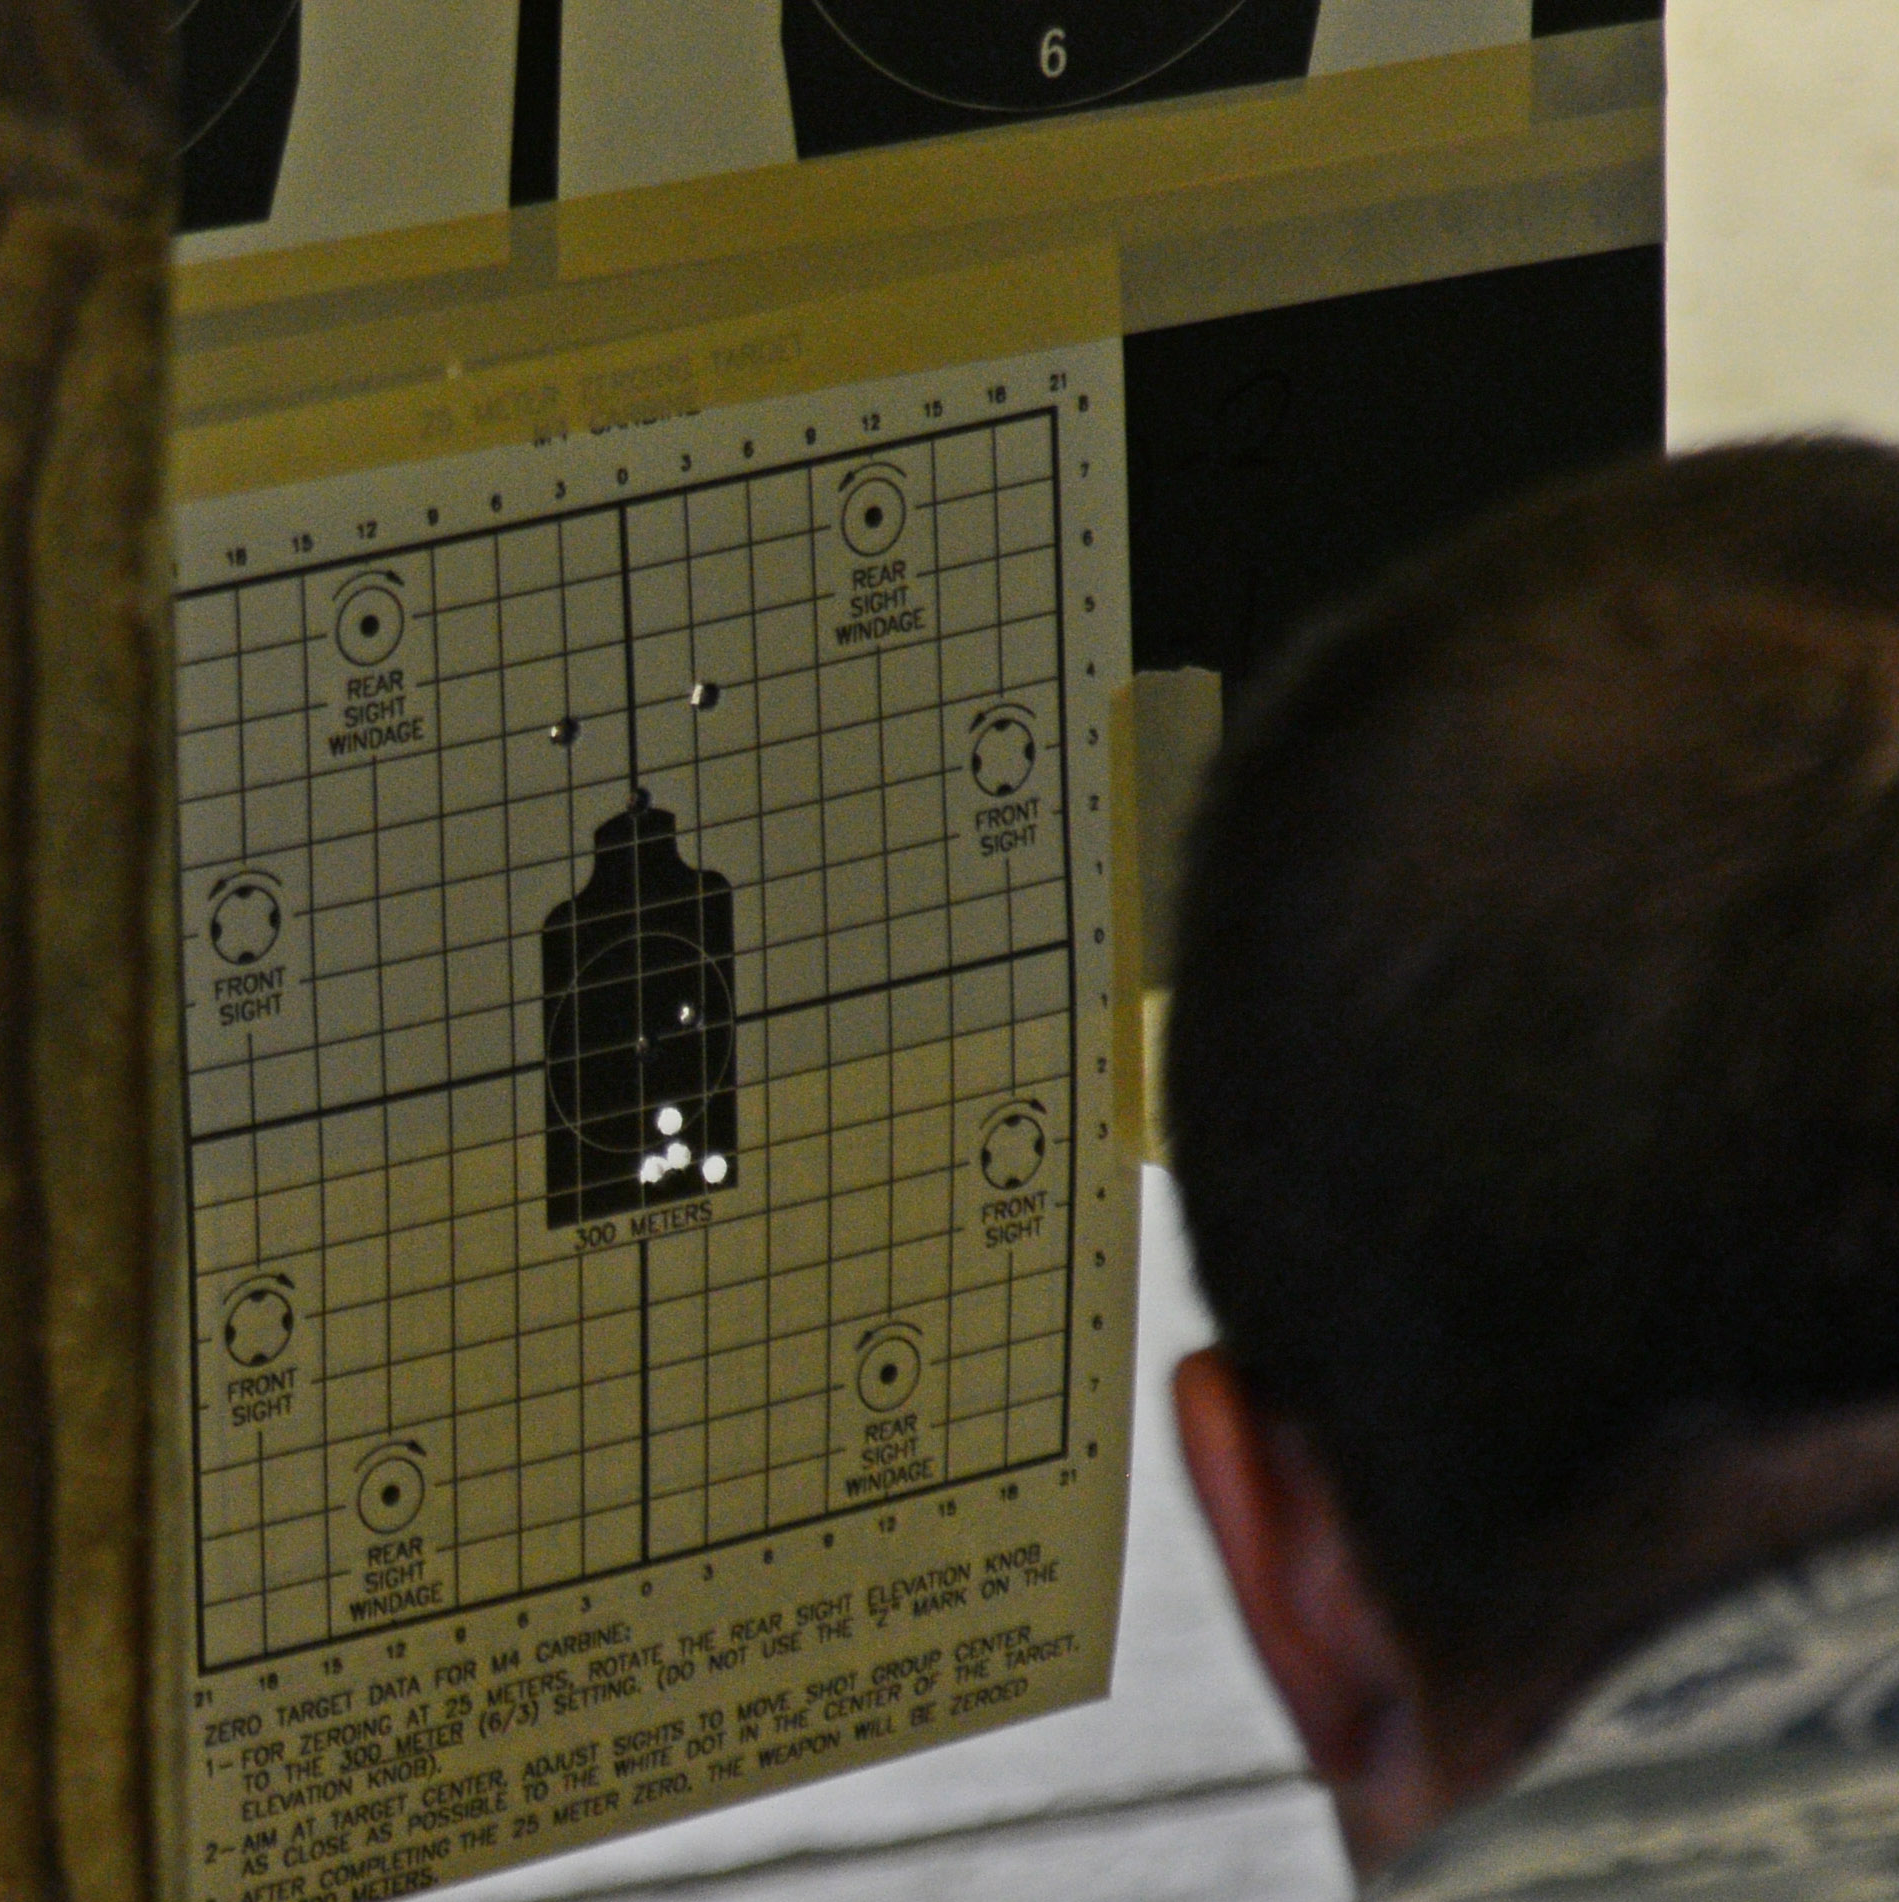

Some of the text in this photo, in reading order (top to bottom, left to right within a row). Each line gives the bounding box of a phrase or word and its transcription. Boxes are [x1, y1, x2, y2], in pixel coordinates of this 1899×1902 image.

[1041, 28, 1067, 78] 6
[356, 520, 377, 539] 12
[556, 480, 565, 499] 3
[618, 468, 628, 484] 0
[681, 454, 691, 472] 3
[862, 413, 880, 431] 12
[924, 400, 943, 417] 15
[1050, 373, 1066, 391] 21
[1081, 462, 1089, 477] 7
[1083, 530, 1093, 545] 6
[853, 561, 906, 590] REAR
[852, 586, 908, 618] SIGHT
[1085, 596, 1095, 612] 5
[836, 608, 925, 645] WINDAGE
[347, 670, 403, 699] REAR
[1087, 661, 1095, 677] 4
[344, 696, 406, 728] SIGHT
[328, 718, 424, 757] WINDAGE
[1088, 728, 1099, 745] 3
[975, 798, 1040, 831] FRONT
[1090, 795, 1099, 811] 2
[981, 825, 1036, 856] SIGHT
[1096, 861, 1103, 875] 1
[1095, 928, 1104, 944] 0
[214, 967, 286, 999] FRONT
[219, 994, 282, 1026] SIGHT
[982, 1191, 1047, 1223] FRONT
[575, 1201, 712, 1249] 300 METERS
[986, 1217, 1043, 1248] SIGHT
[227, 1368, 298, 1400] FRONT
[1089, 1377, 1098, 1392] 7
[231, 1394, 293, 1427] SIGHT
[865, 1414, 917, 1441] REAR
[862, 1439, 917, 1467] SIGHT
[845, 1458, 933, 1497] WINDAGE
[368, 1536, 423, 1566] REAR
[364, 1560, 426, 1593] SIGHT
[581, 1597, 591, 1612] 3
[642, 1582, 652, 1596] 0
[703, 1563, 714, 1581] 3
[350, 1582, 442, 1621] WINDAGE
[241, 1742, 284, 1769] FOR
[300, 1715, 392, 1755] ZEROING
[407, 1706, 430, 1727] AT
[446, 1696, 472, 1719] 25
[589, 1644, 663, 1680] ROTATE
[679, 1630, 717, 1656] THE
[731, 1612, 782, 1642] REAR
[797, 1594, 852, 1626] SIGHT
[868, 1563, 971, 1606] ELEVATION
[985, 1543, 1040, 1574] KNOB
[243, 1771, 269, 1792] TO
[286, 1758, 324, 1783] THE
[340, 1744, 381, 1773] 300
[397, 1722, 464, 1753] METER
[657, 1662, 695, 1691] (DO
[708, 1648, 748, 1673] NOT
[762, 1632, 801, 1659] USE
[817, 1619, 853, 1643] THE
[913, 1588, 966, 1618] MARK
[980, 1577, 1009, 1600] ON
[1024, 1562, 1058, 1586] THE
[204, 1715, 262, 1748] ZERO
[277, 1691, 352, 1728] TARGET
[369, 1676, 421, 1706] DATA
[435, 1661, 476, 1688] FOR
[492, 1651, 519, 1674] M4
[242, 1830, 277, 1855] AIM
[292, 1819, 317, 1841] AT
[331, 1796, 407, 1828] TARGET
[524, 1744, 598, 1780] ADJUST
[612, 1721, 684, 1752] SIGHTS
[698, 1711, 724, 1730] TO
[738, 1693, 790, 1723] MOVE
[806, 1673, 857, 1701] SHOT
[871, 1650, 942, 1685] GROUP
[954, 1626, 1030, 1661] CENTER
[242, 1635, 1079, 1877] AS CLOSE AS POSSIBLE TO THE WHITE DOT IN THE CENTER OF THE TARGET.
[320, 1841, 449, 1889] COMPLETING
[460, 1825, 499, 1851] THE
[513, 1815, 539, 1838] 25
[553, 1792, 619, 1825] METER
[634, 1773, 692, 1805] ZERO.
[708, 1757, 742, 1782] THE
[757, 1732, 840, 1769] WEAPON
[854, 1717, 895, 1741] WILL
[911, 1704, 937, 1725] BE
[950, 1678, 1027, 1716] ZEROED
[242, 1778, 352, 1822] ELEVATION
